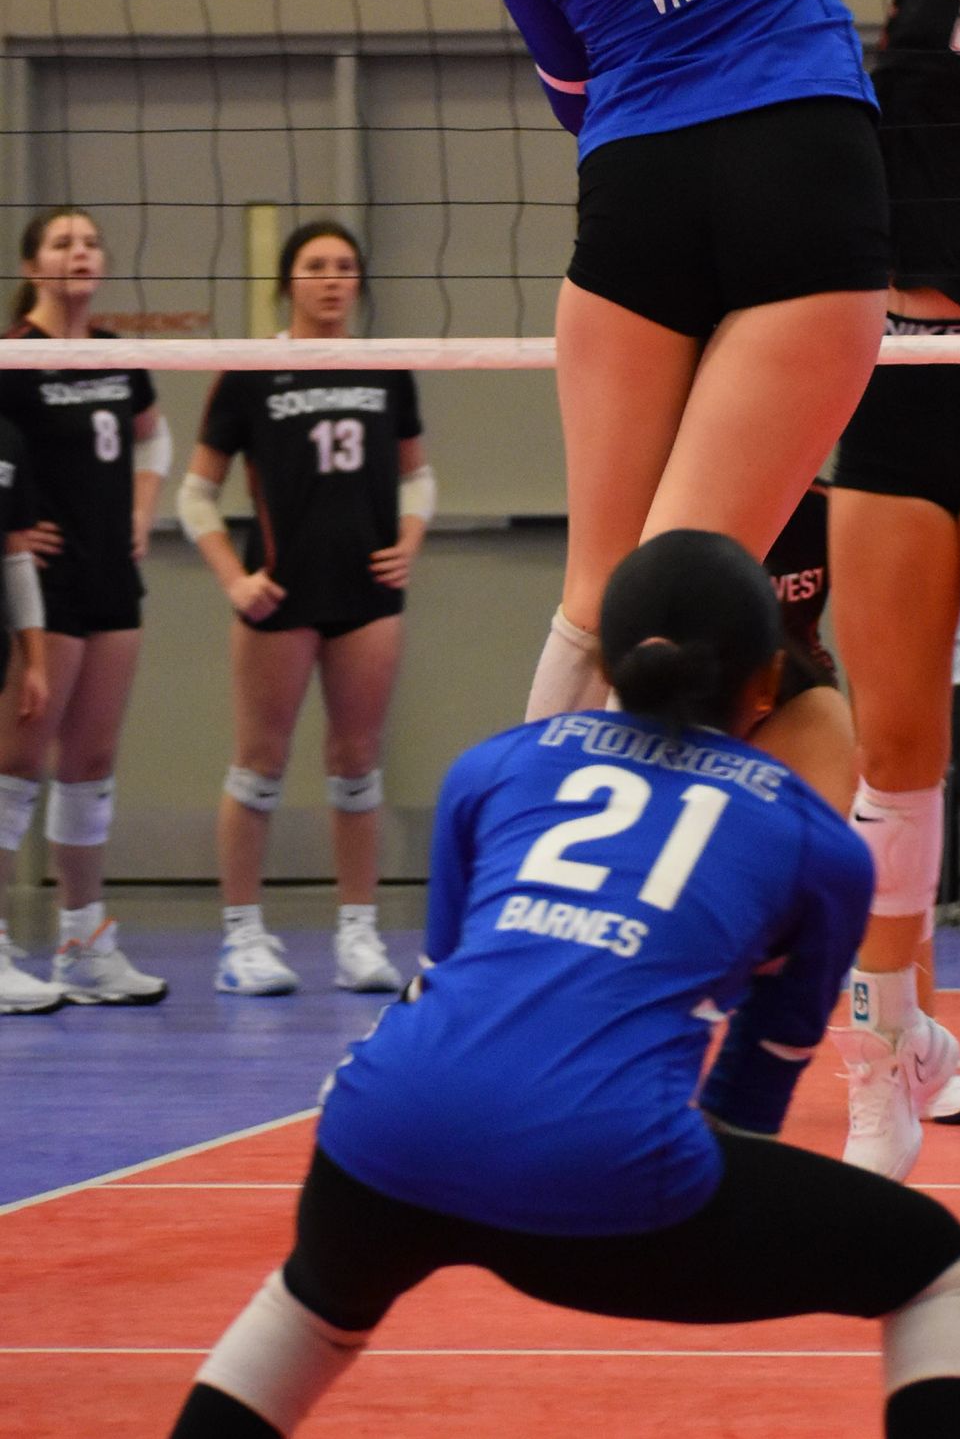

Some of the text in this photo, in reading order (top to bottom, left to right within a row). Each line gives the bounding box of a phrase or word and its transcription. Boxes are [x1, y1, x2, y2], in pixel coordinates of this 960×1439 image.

[91, 410, 121, 462] 8
[309, 418, 365, 473] 13
[515, 764, 731, 912] 21
[494, 895, 650, 958] BARNES
